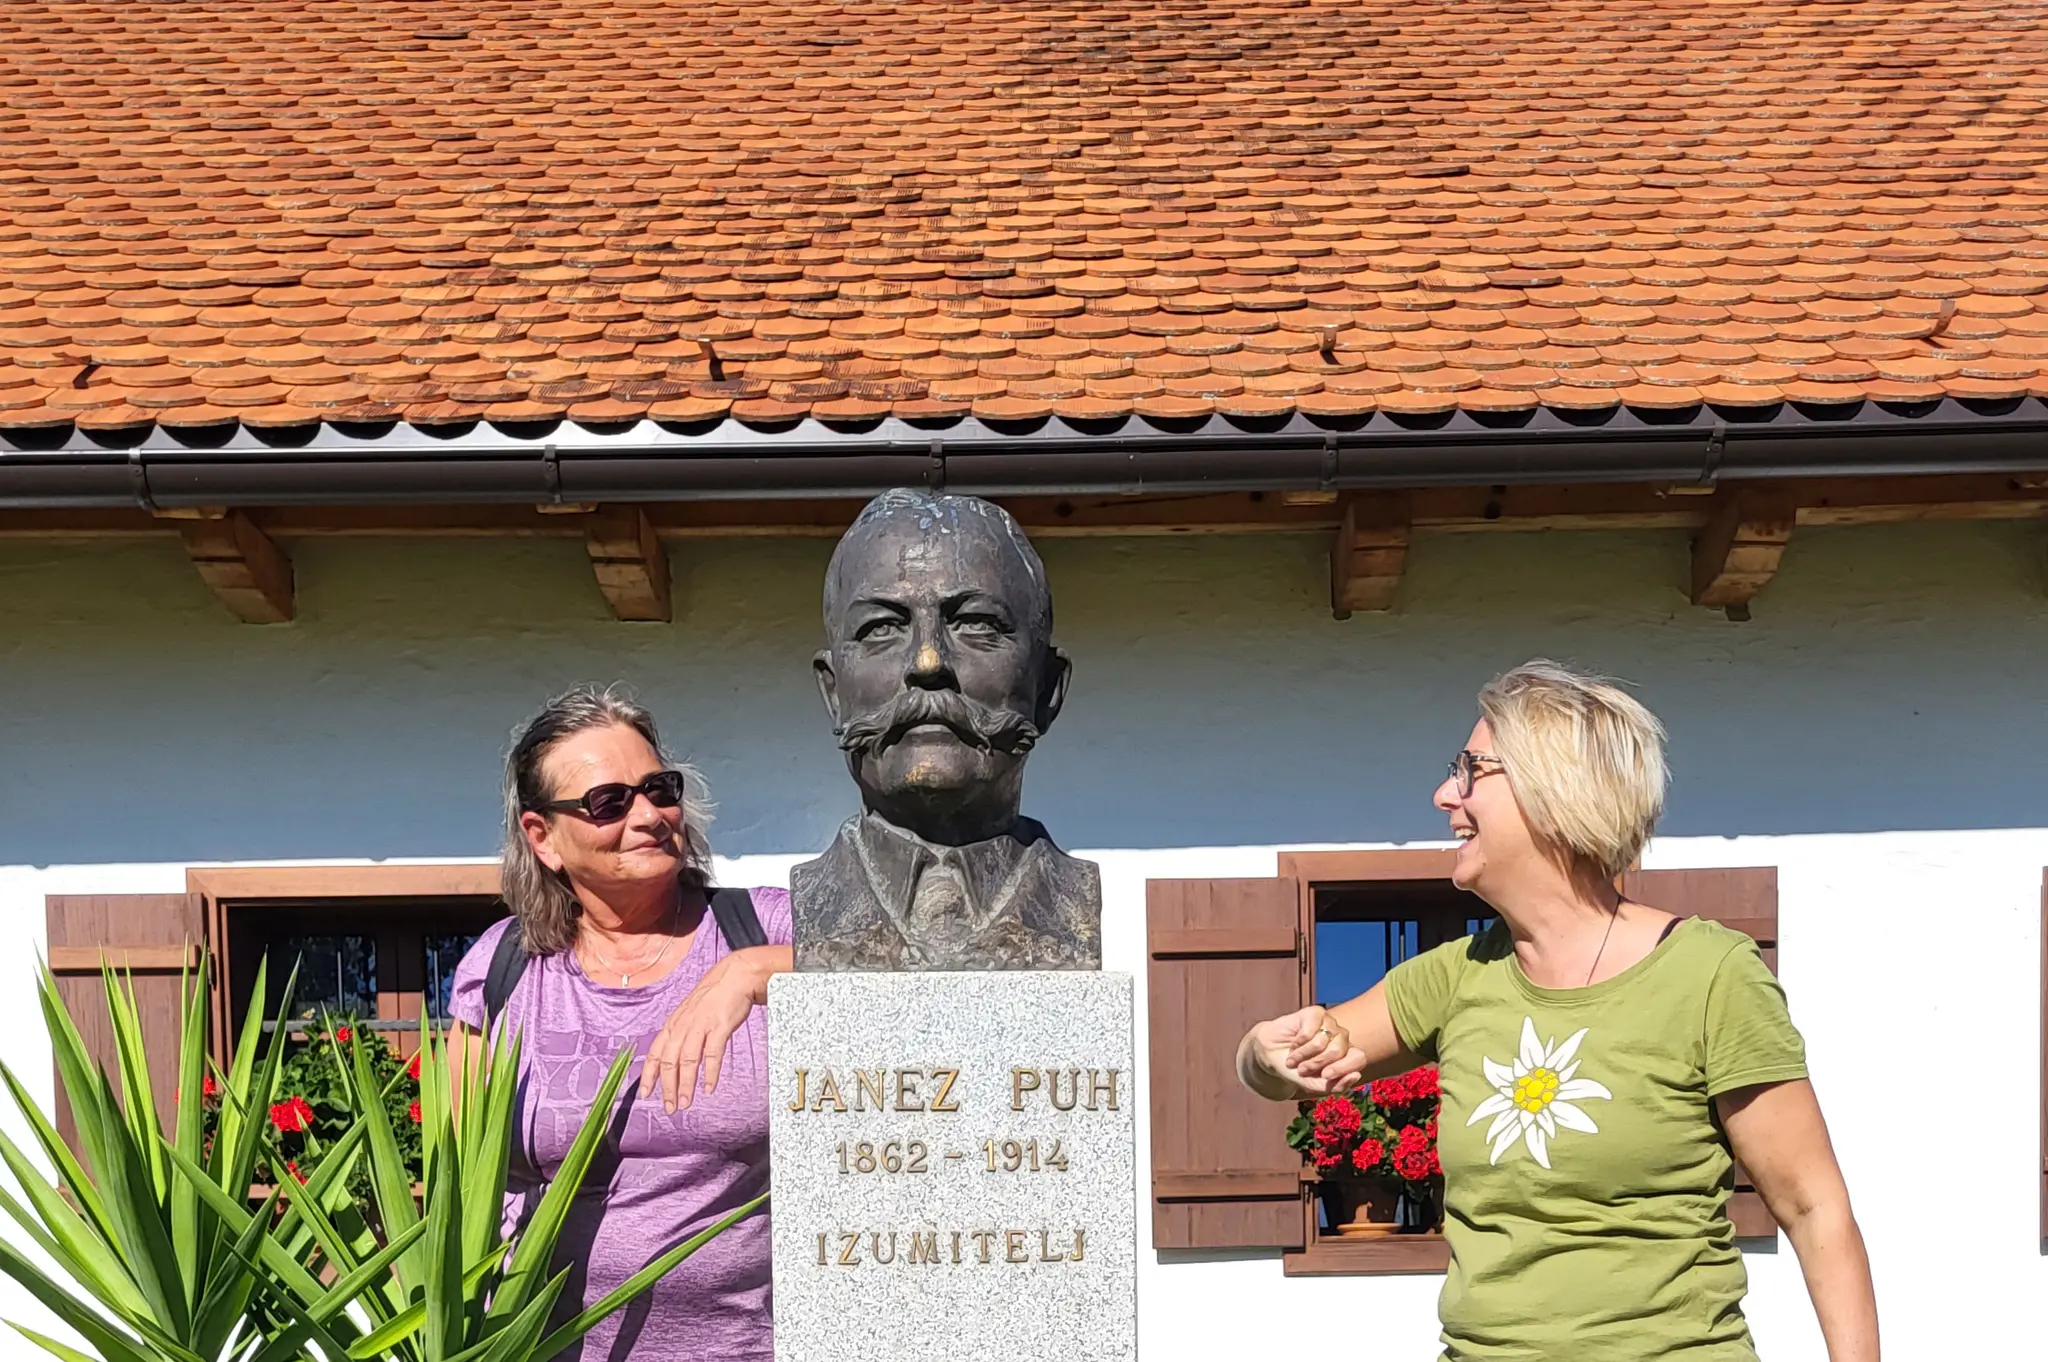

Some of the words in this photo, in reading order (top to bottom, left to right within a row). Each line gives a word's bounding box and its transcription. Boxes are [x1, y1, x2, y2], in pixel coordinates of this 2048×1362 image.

[788, 1068, 960, 1112] JANEZ
[1009, 1067, 1120, 1111] PUH
[835, 1139, 928, 1174] 1862
[982, 1138, 1070, 1173] 1914
[816, 1229, 1086, 1266] IZUMITELJ
